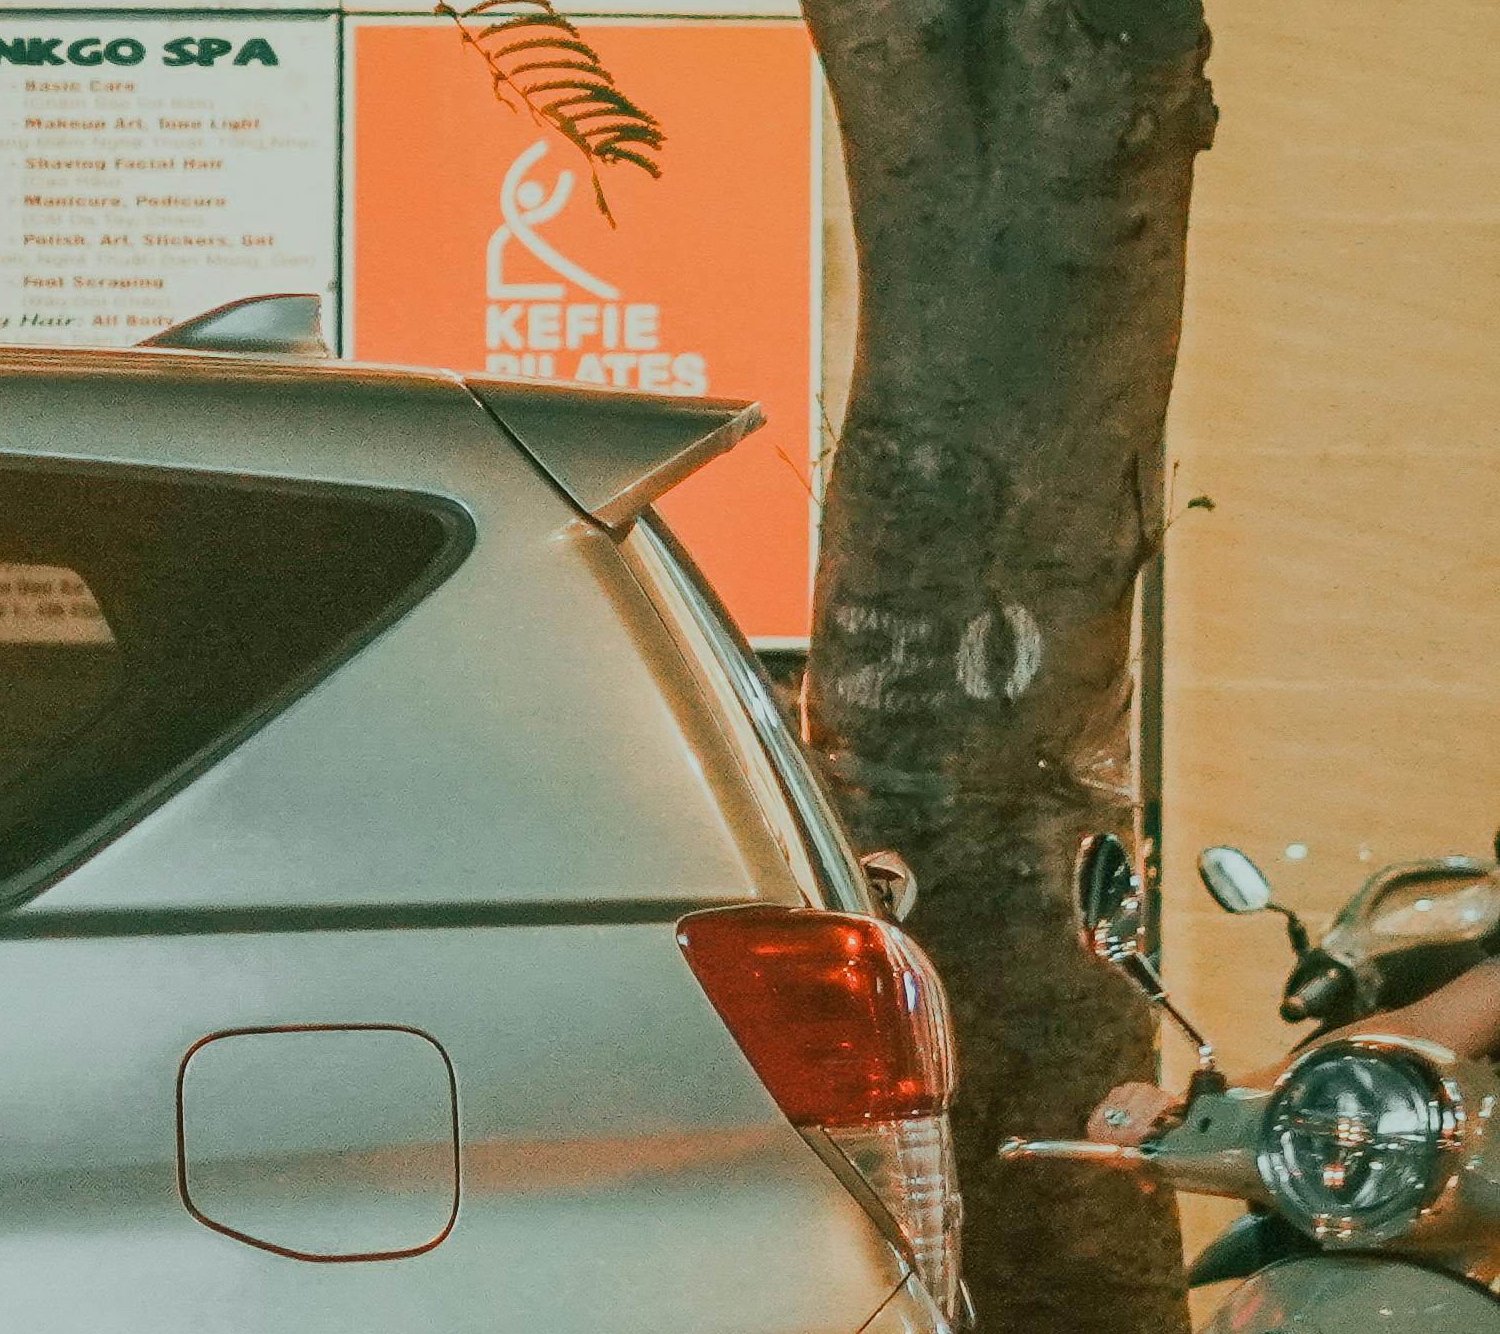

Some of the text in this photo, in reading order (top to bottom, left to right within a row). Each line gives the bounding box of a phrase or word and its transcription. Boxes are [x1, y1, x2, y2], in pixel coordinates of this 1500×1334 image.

[162, 37, 280, 67] SPA
[135, 195, 228, 208] Pedicure
[485, 303, 660, 350] KEFIE
